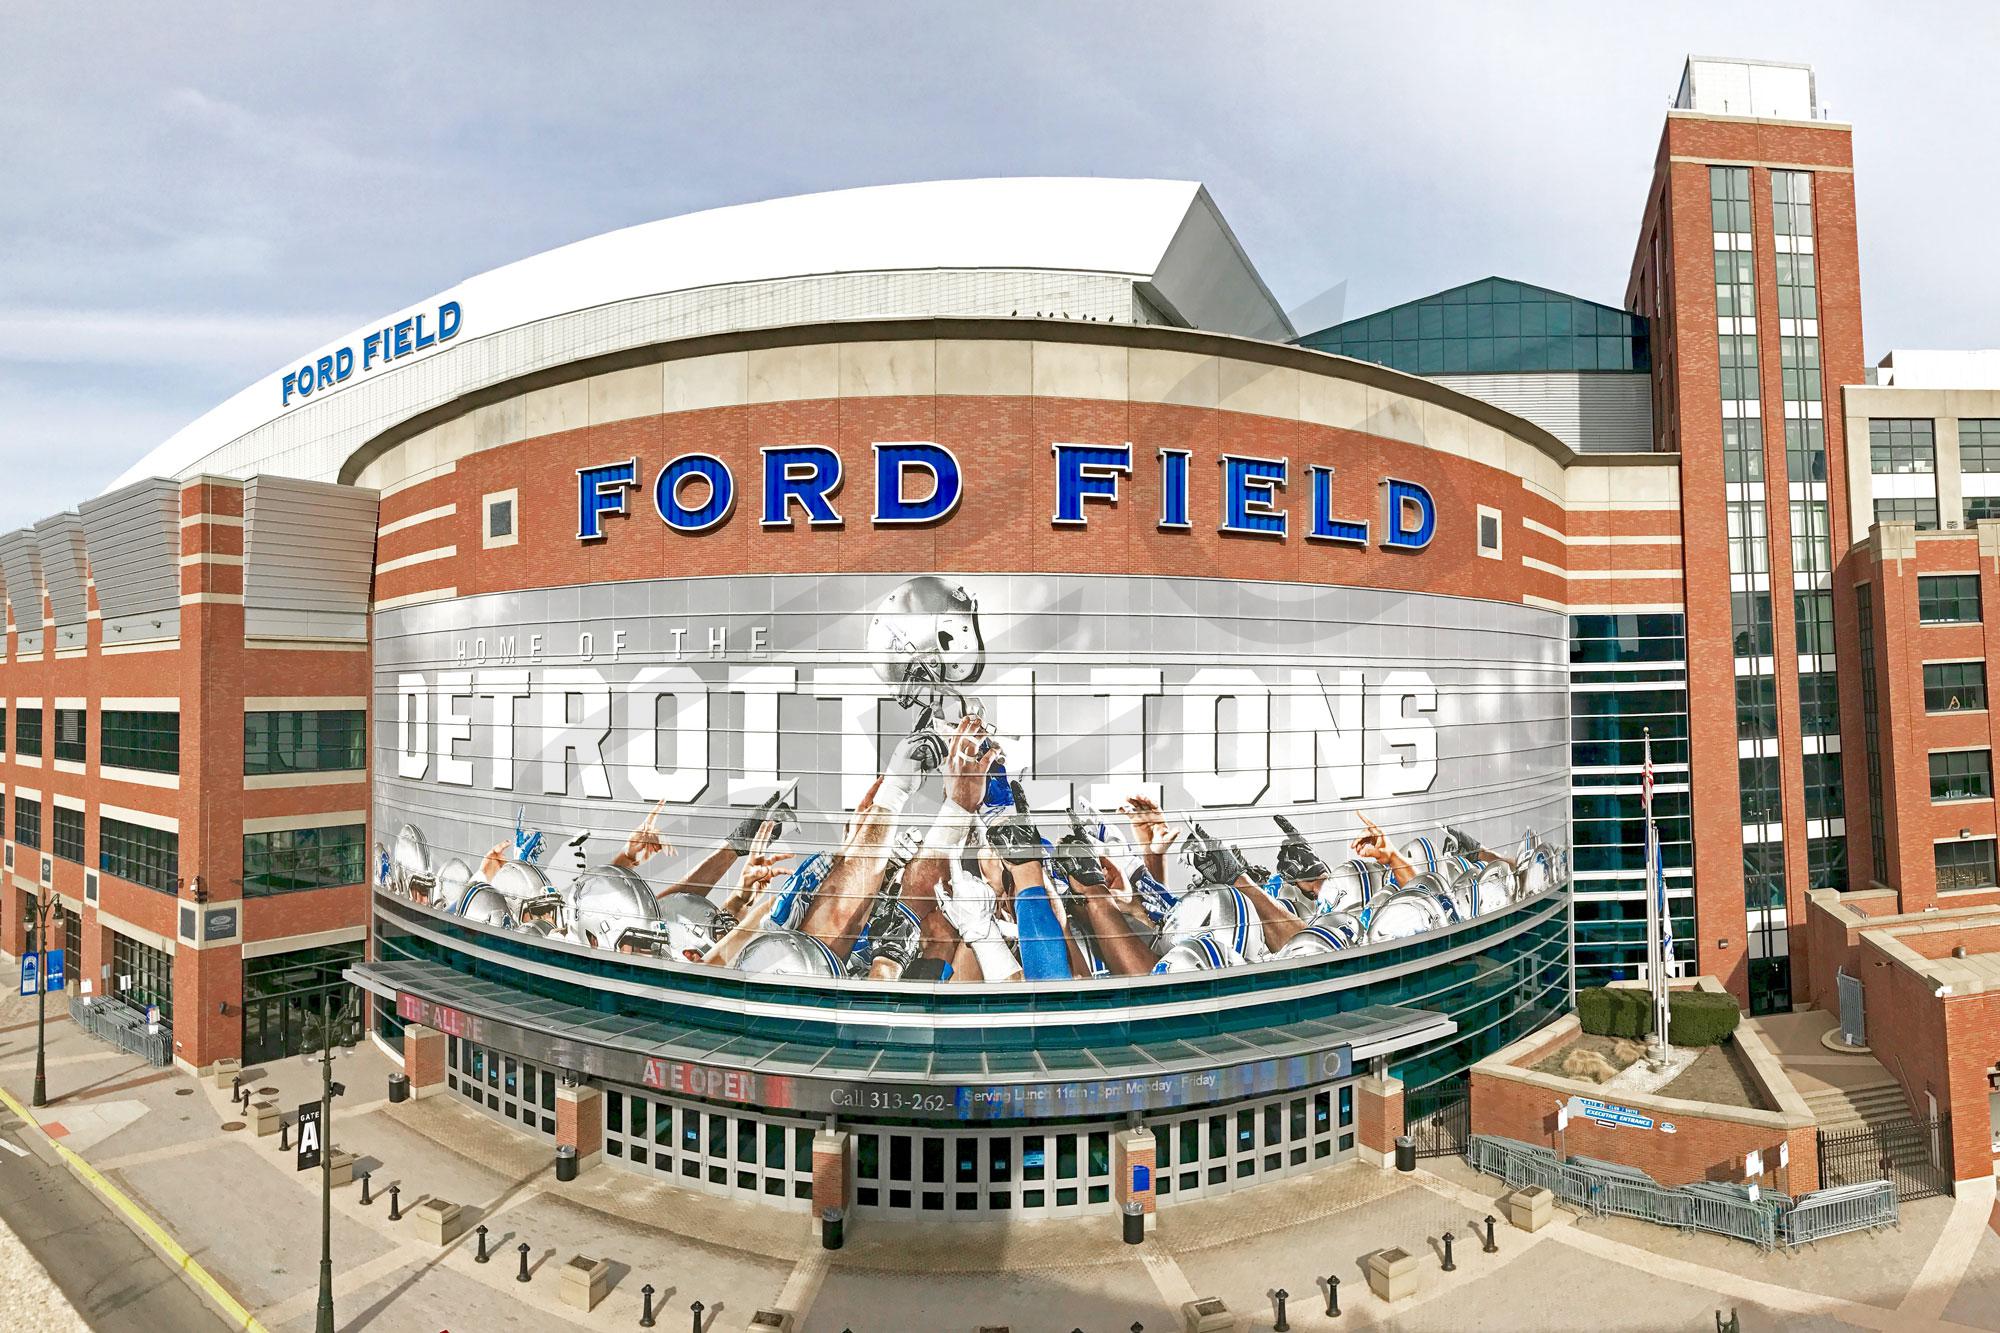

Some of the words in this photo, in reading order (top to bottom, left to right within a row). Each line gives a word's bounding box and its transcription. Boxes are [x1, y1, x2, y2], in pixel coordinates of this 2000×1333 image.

[282, 346, 356, 407] FORD
[363, 301, 464, 372] FIELD
[575, 441, 963, 541] FORD
[1050, 441, 1438, 551] FIELD
[456, 632, 543, 666] HOME
[578, 630, 627, 662] OF
[670, 626, 769, 660] THE
[397, 666, 899, 813] DETROIT
[996, 667, 1438, 813] LIONS
[642, 1059, 684, 1090] ATE
[690, 1067, 756, 1102] OPEN
[1126, 1080, 1173, 1095] Monday
[1181, 1074, 1217, 1088] Friday
[300, 1111, 320, 1121] GATE
[830, 1088, 865, 1107] Call
[869, 1091, 954, 1112] 313-262-
[300, 1121, 319, 1153] A
[1619, 1114, 1651, 1126] ENTRANCE
